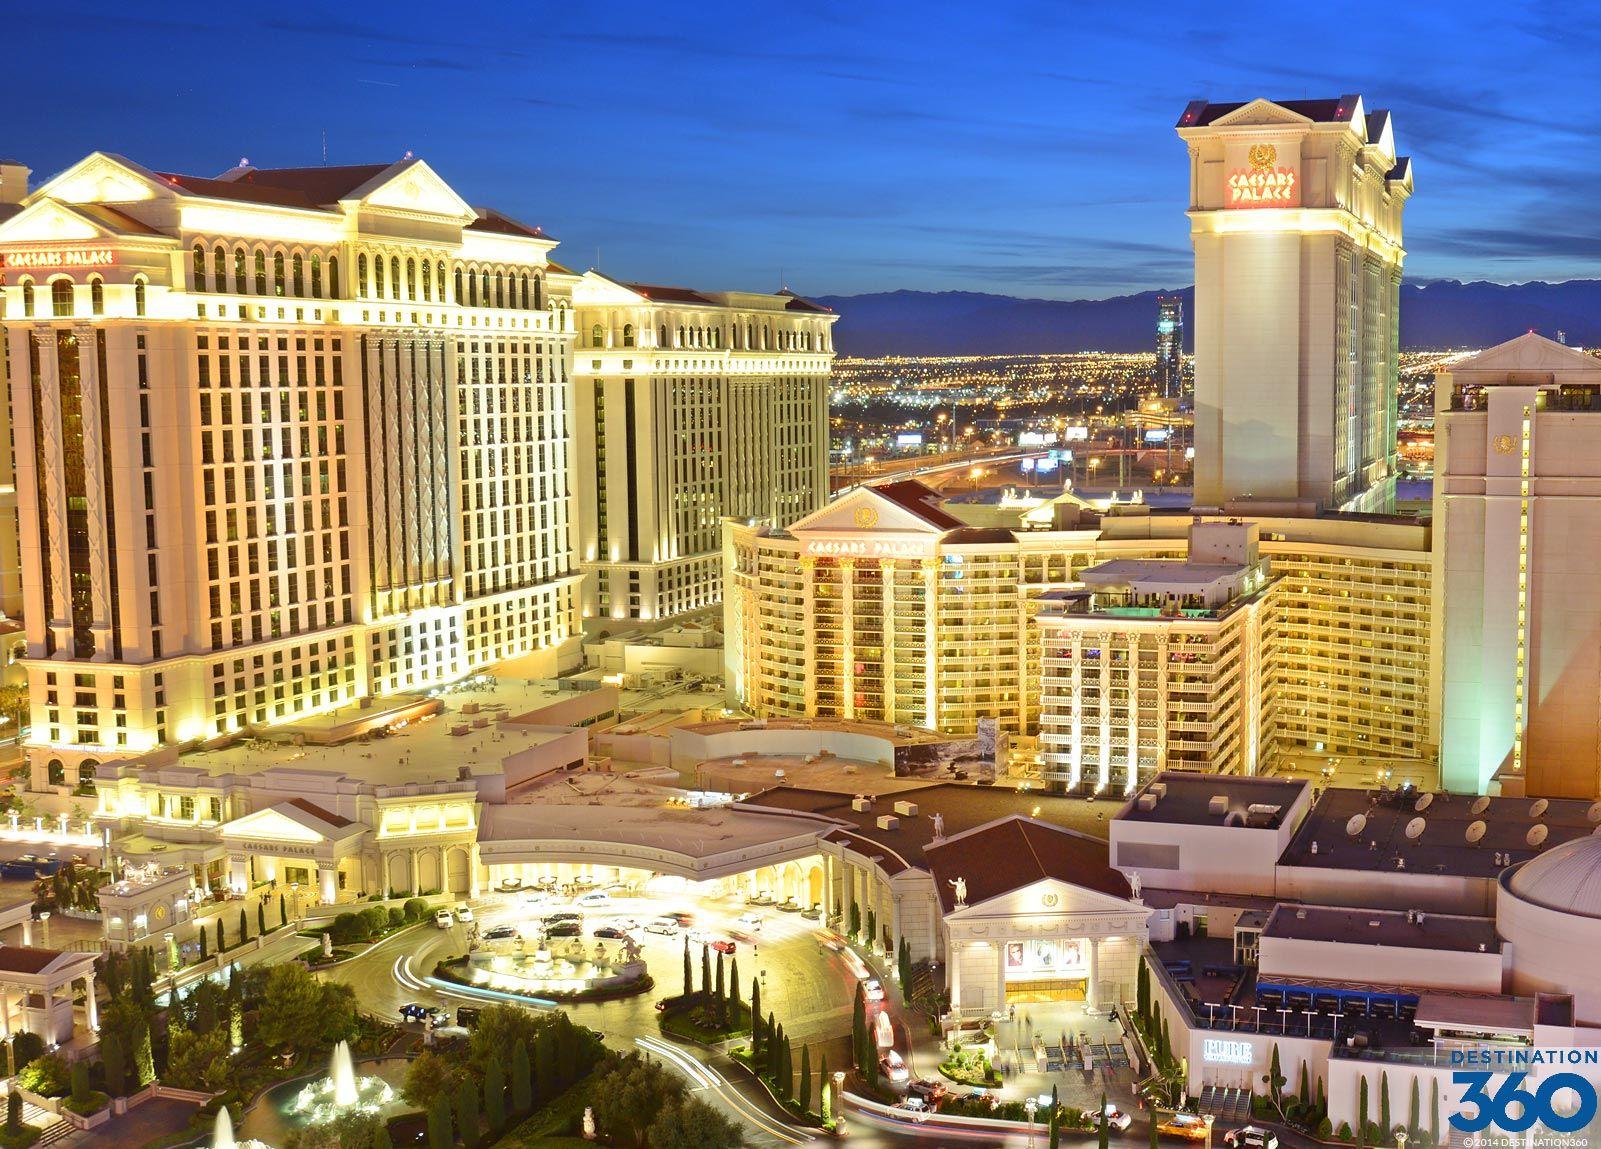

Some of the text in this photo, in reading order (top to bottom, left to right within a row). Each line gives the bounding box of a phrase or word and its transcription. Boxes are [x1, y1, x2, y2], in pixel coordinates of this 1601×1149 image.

[1228, 173, 1295, 187] CAESARS
[1232, 187, 1291, 200] PALACE
[8, 250, 113, 266] CAESARS PALACE
[808, 541, 866, 554] CAESARS
[243, 843, 315, 855] CAESARS PALACE
